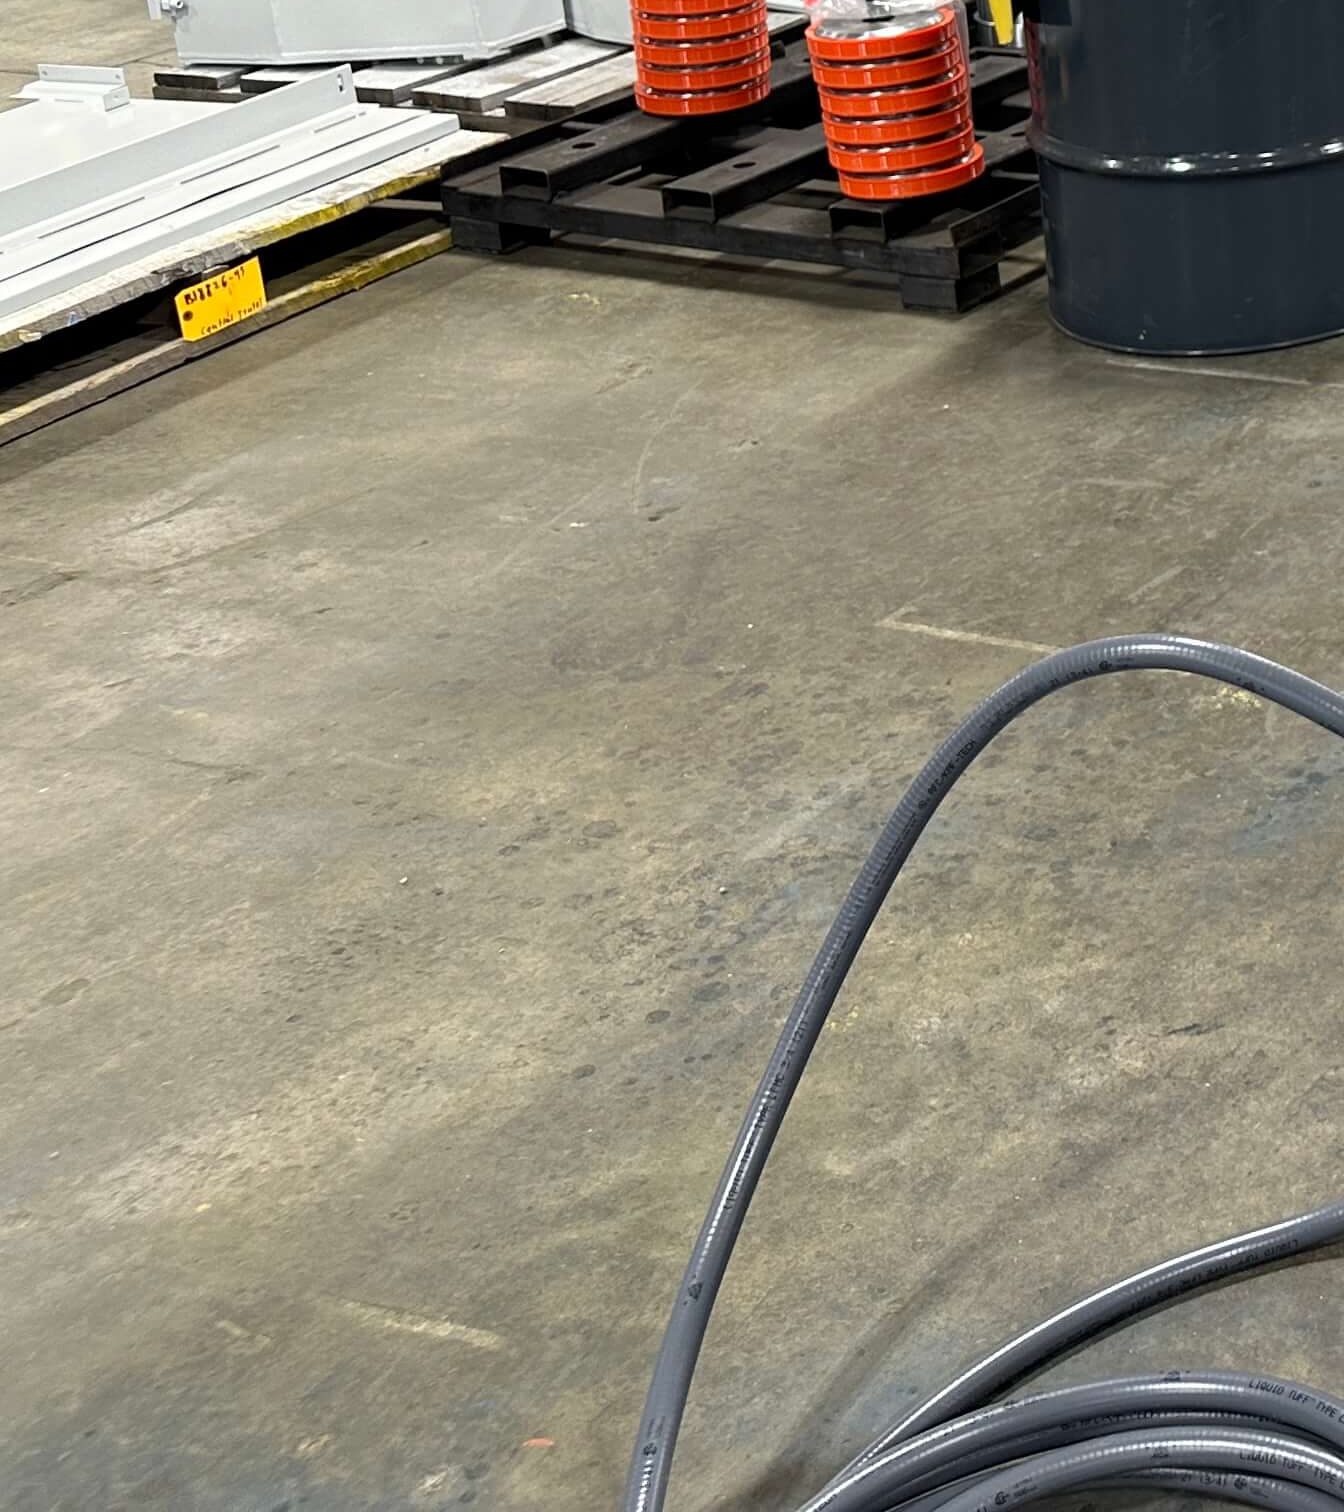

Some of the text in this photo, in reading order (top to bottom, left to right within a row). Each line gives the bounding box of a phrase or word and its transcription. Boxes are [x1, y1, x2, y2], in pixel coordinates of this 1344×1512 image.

[1249, 1378, 1285, 1396] LIQUID
[1314, 1399, 1338, 1419] TYPE
[1239, 1451, 1277, 1465] LIQUID
[1312, 1465, 1338, 1486] TYPE
